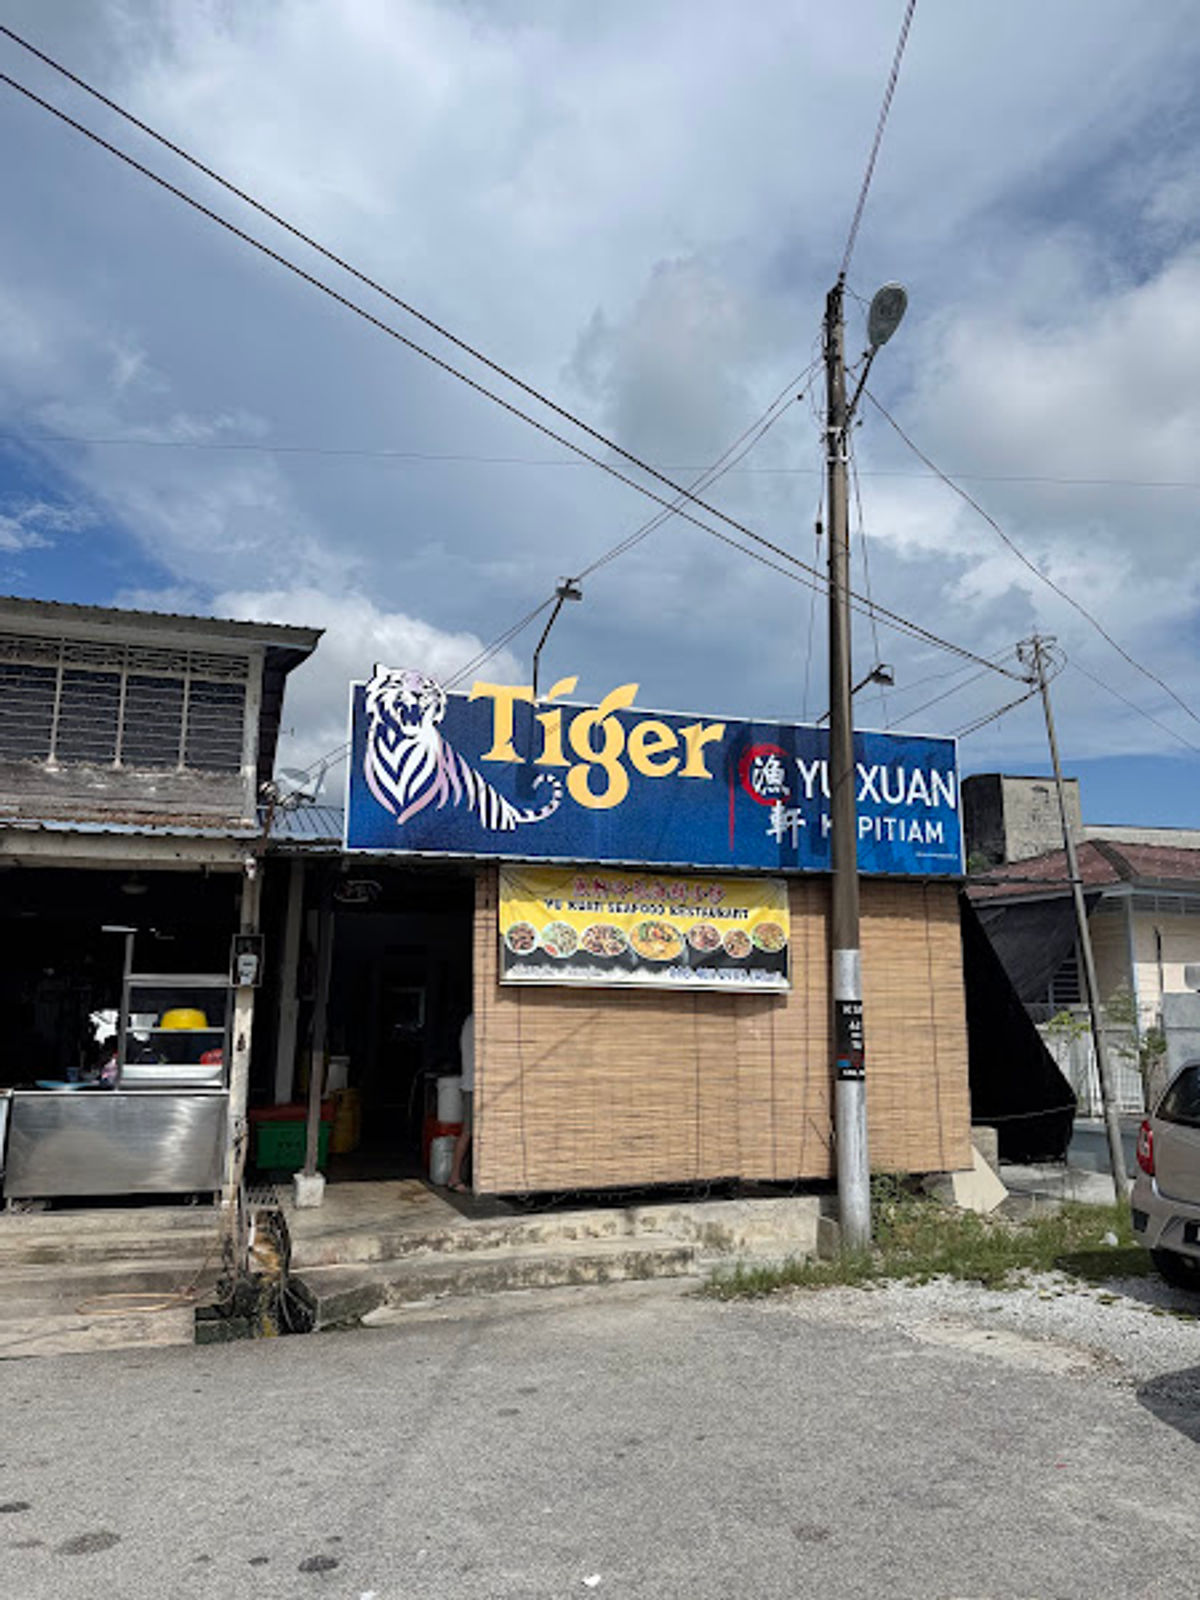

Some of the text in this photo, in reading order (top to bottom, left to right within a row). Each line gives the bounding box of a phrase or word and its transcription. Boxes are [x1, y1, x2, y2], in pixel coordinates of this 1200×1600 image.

[469, 676, 725, 809] Tiger
[856, 763, 956, 809] XUAN
[821, 813, 943, 844] KPITIAM
[608, 902, 665, 916] SEAFOOD
